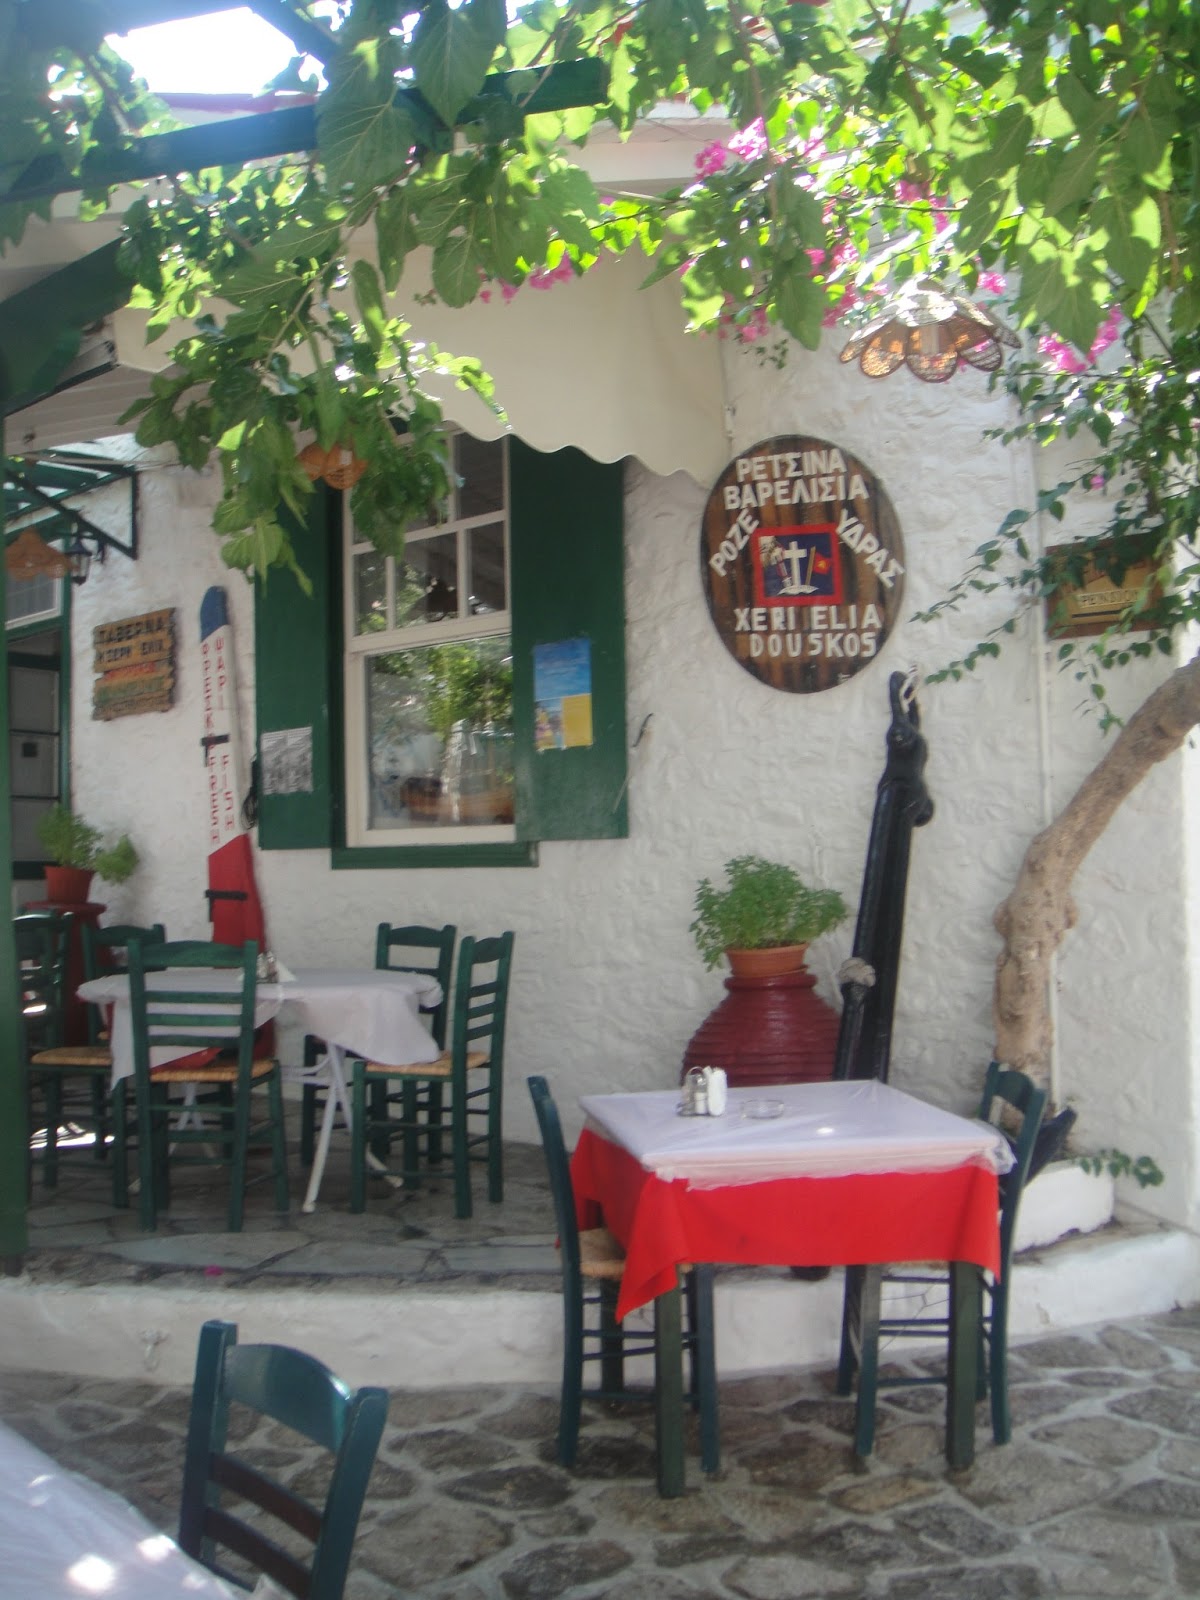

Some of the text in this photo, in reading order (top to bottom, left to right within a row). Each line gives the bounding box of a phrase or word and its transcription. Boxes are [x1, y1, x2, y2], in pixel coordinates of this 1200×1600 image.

[736, 448, 847, 483] ΡΕΤΣΙΝΑ
[724, 474, 869, 511] ΒΑΡΕΛΙΣΙΑ
[708, 508, 760, 577] ΡΟΖΕ
[834, 508, 906, 588] ΥΔΡΑΣ
[734, 604, 882, 632] XERI ELIA
[749, 632, 877, 658] DOUSKOS
[208, 755, 220, 844] FRESH
[221, 754, 235, 831] FISH
